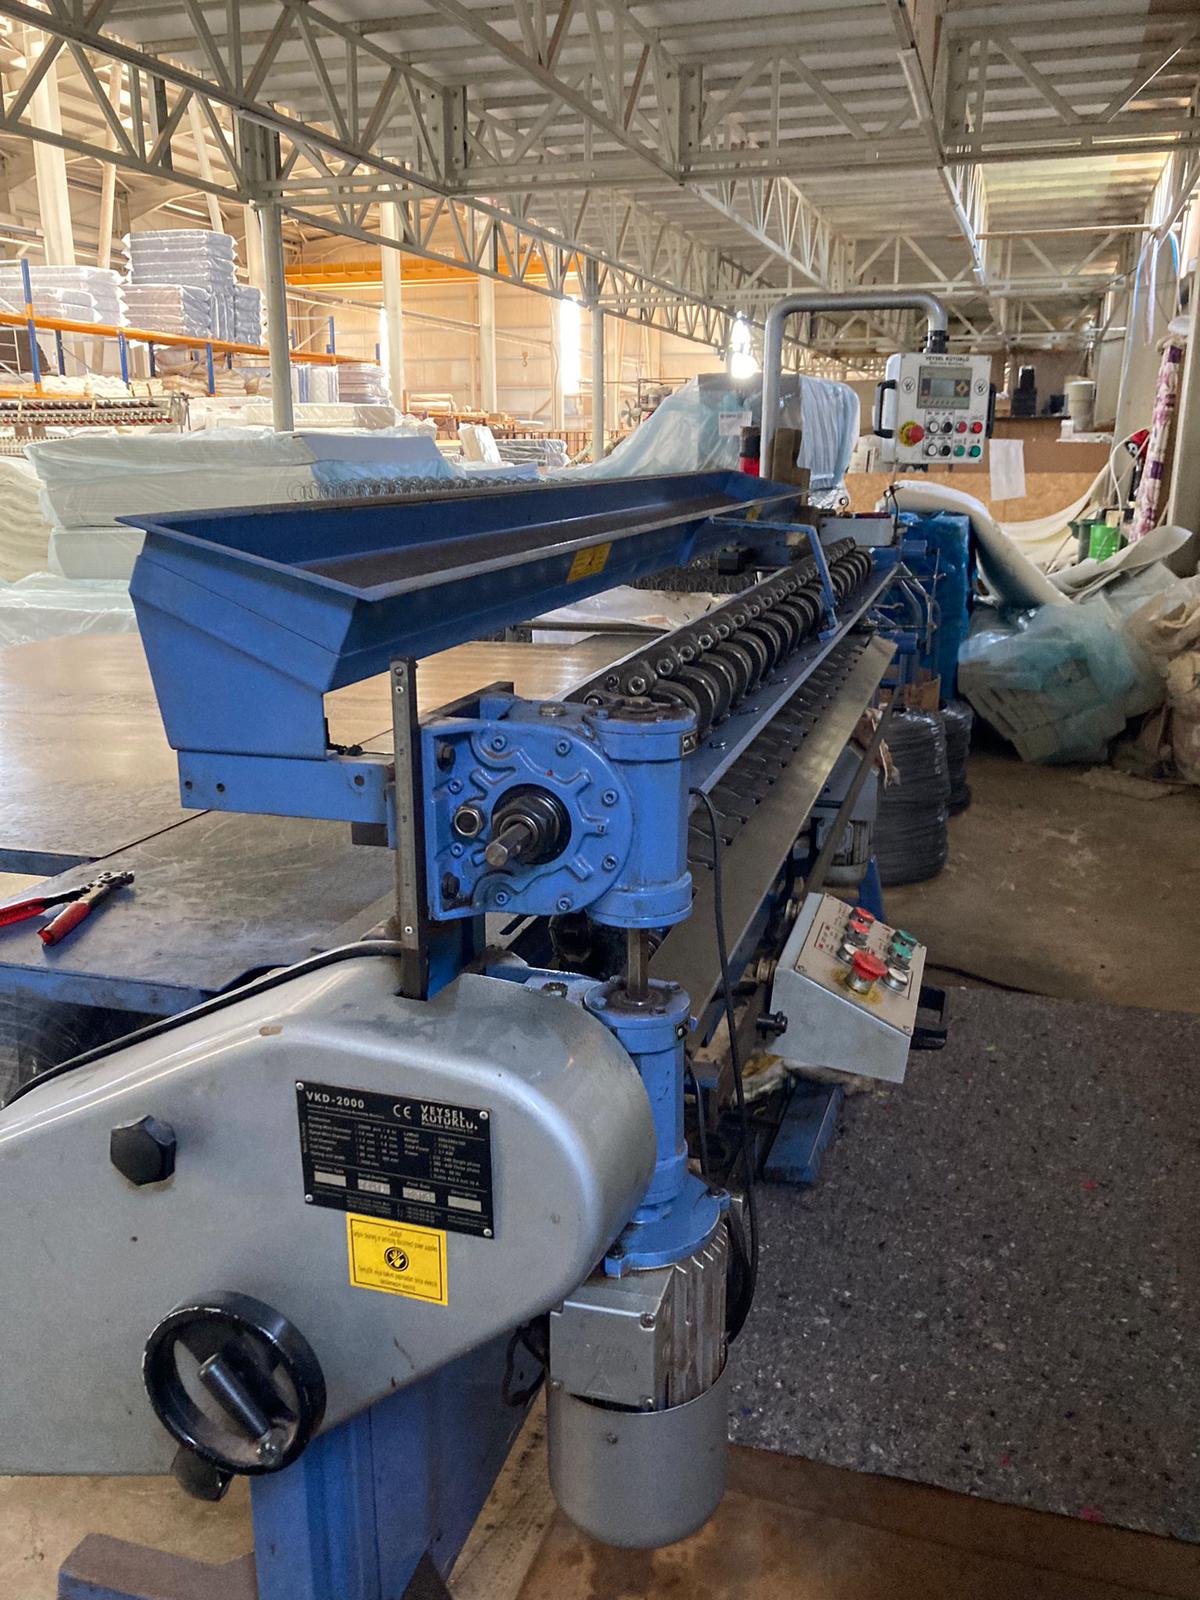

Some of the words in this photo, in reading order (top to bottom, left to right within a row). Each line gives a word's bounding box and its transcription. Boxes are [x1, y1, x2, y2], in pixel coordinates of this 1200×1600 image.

[305, 1090, 365, 1109] VKD-2000
[392, 1104, 412, 1120] CE
[421, 1104, 466, 1121] VEYSEL
